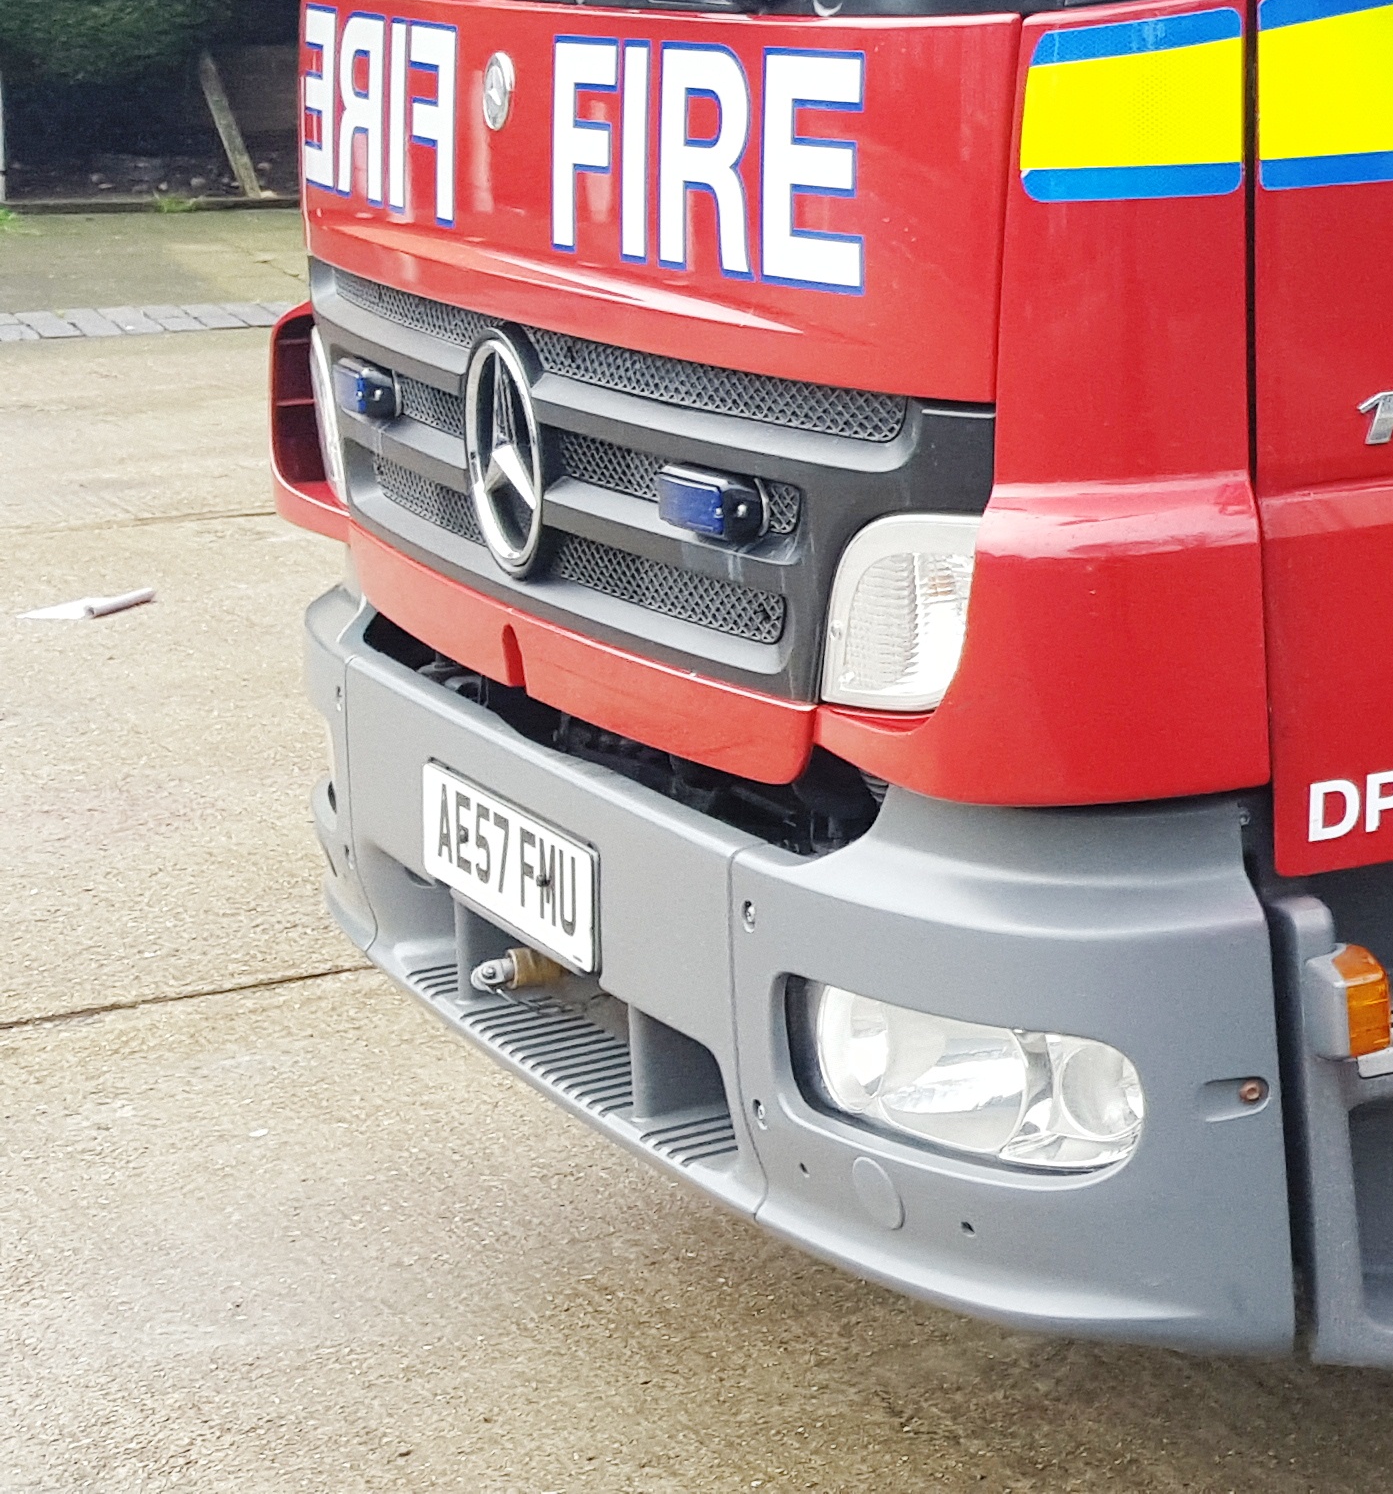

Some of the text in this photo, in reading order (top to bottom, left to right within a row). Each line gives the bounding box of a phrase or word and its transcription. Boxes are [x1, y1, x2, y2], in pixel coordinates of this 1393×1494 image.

[551, 32, 866, 296] FIRE
[437, 782, 577, 937] AE57 FMU
